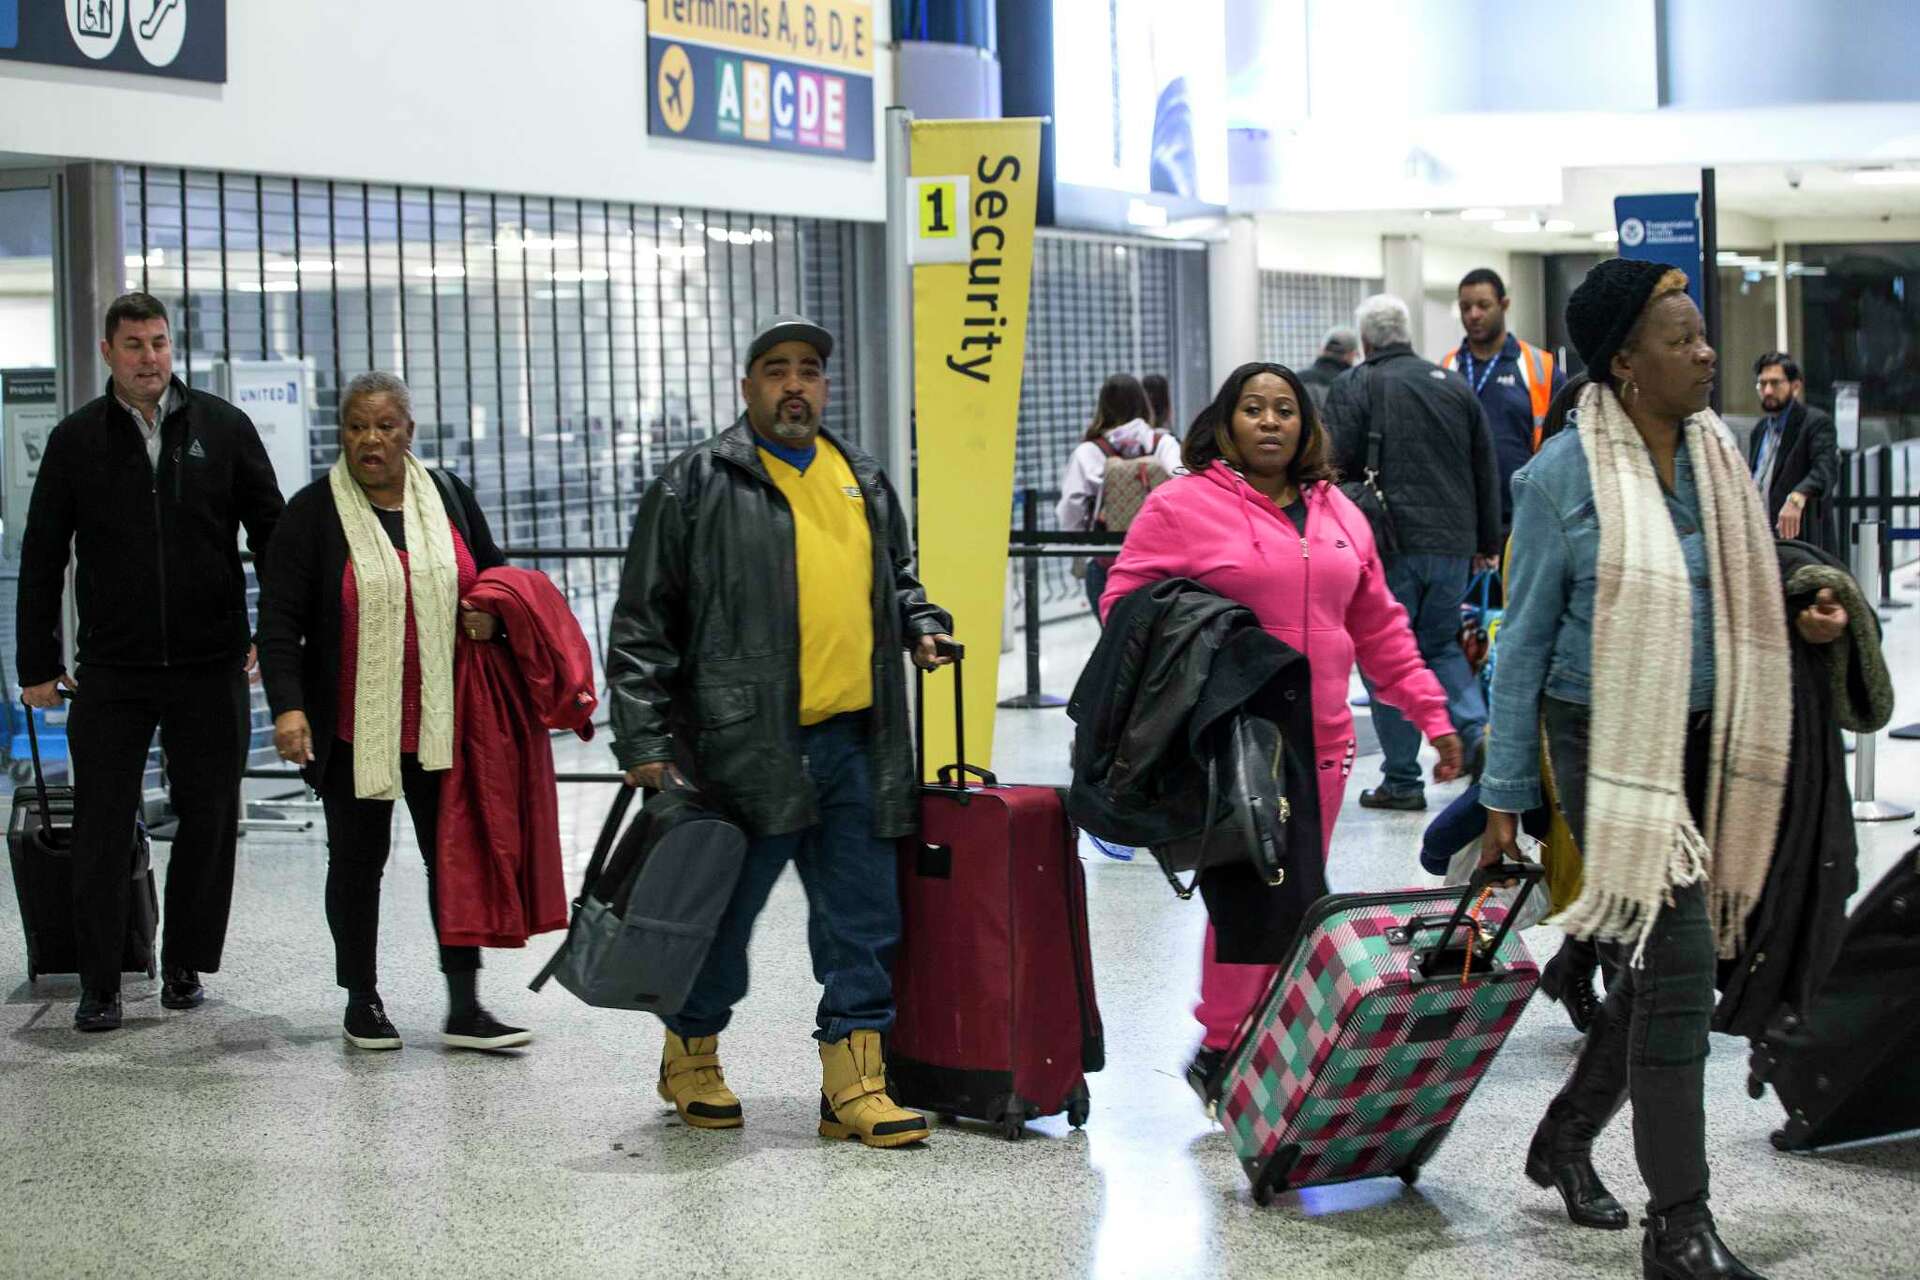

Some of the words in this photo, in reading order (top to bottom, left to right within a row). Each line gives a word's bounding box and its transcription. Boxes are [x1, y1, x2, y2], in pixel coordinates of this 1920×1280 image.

[854, 16, 865, 57] E
[926, 187, 949, 232] 1
[946, 154, 1021, 383] Security
[240, 387, 285, 402] UNITED
